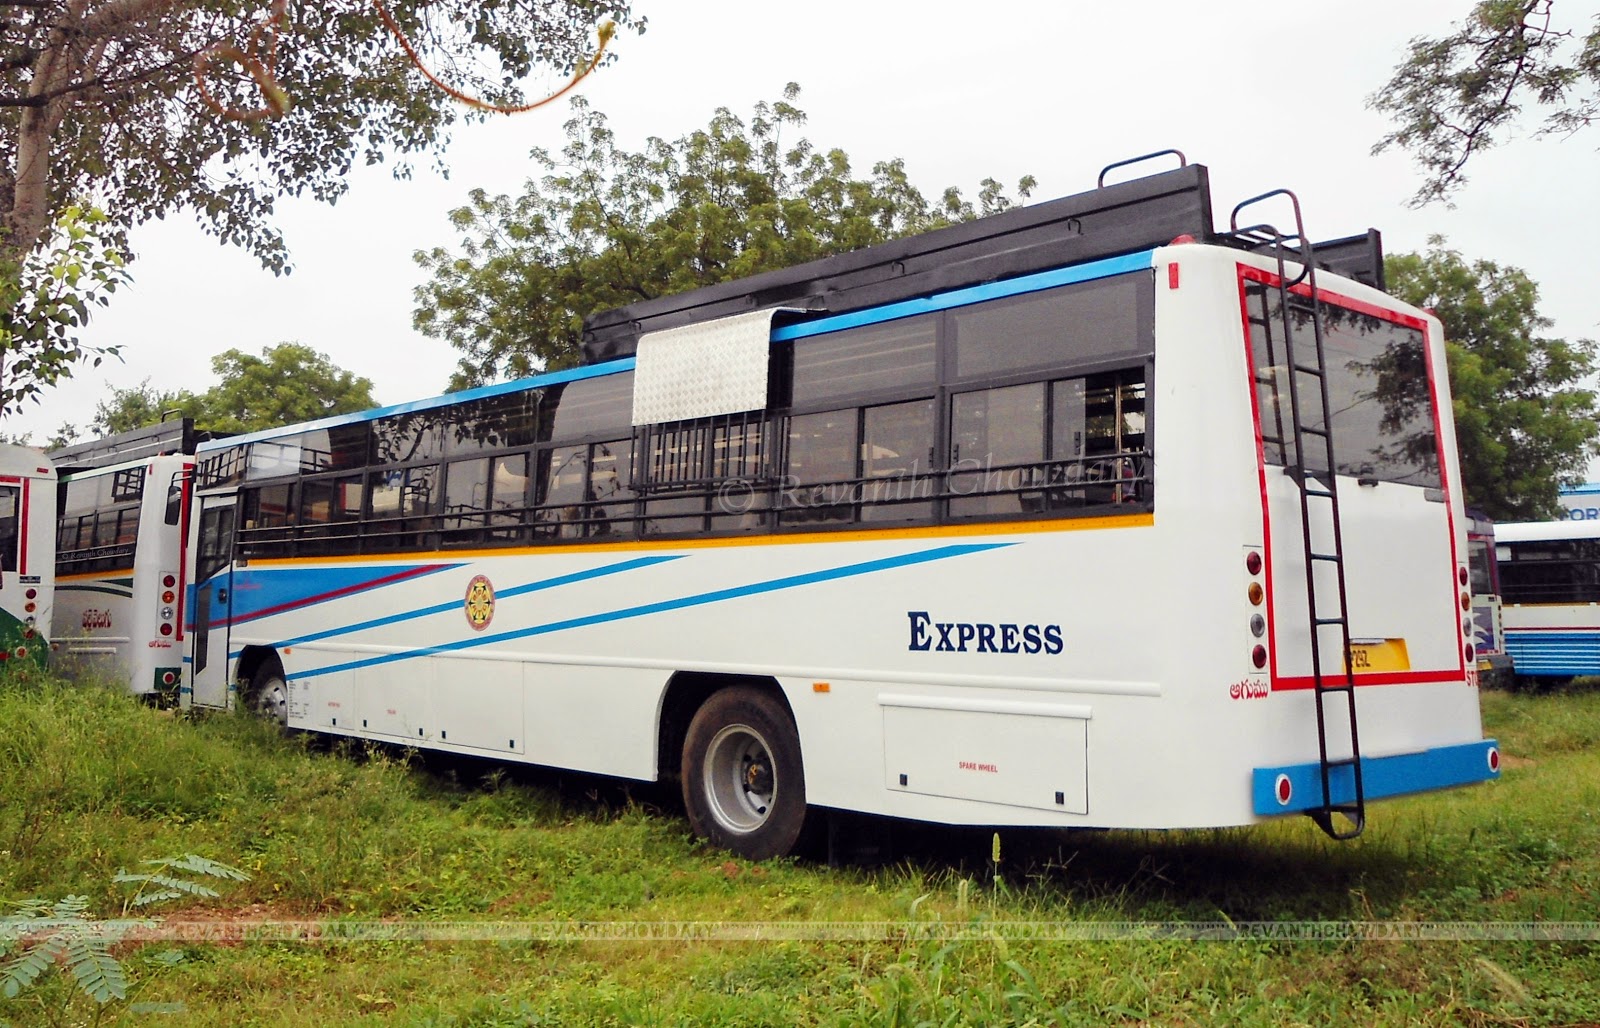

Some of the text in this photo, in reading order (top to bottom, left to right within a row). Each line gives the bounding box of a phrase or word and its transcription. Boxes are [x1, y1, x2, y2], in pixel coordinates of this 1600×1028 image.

[907, 611, 1064, 655] EXPRESS
[1229, 679, 1269, 700] ఆగుము
[959, 761, 998, 773] SPARE WHEEL
